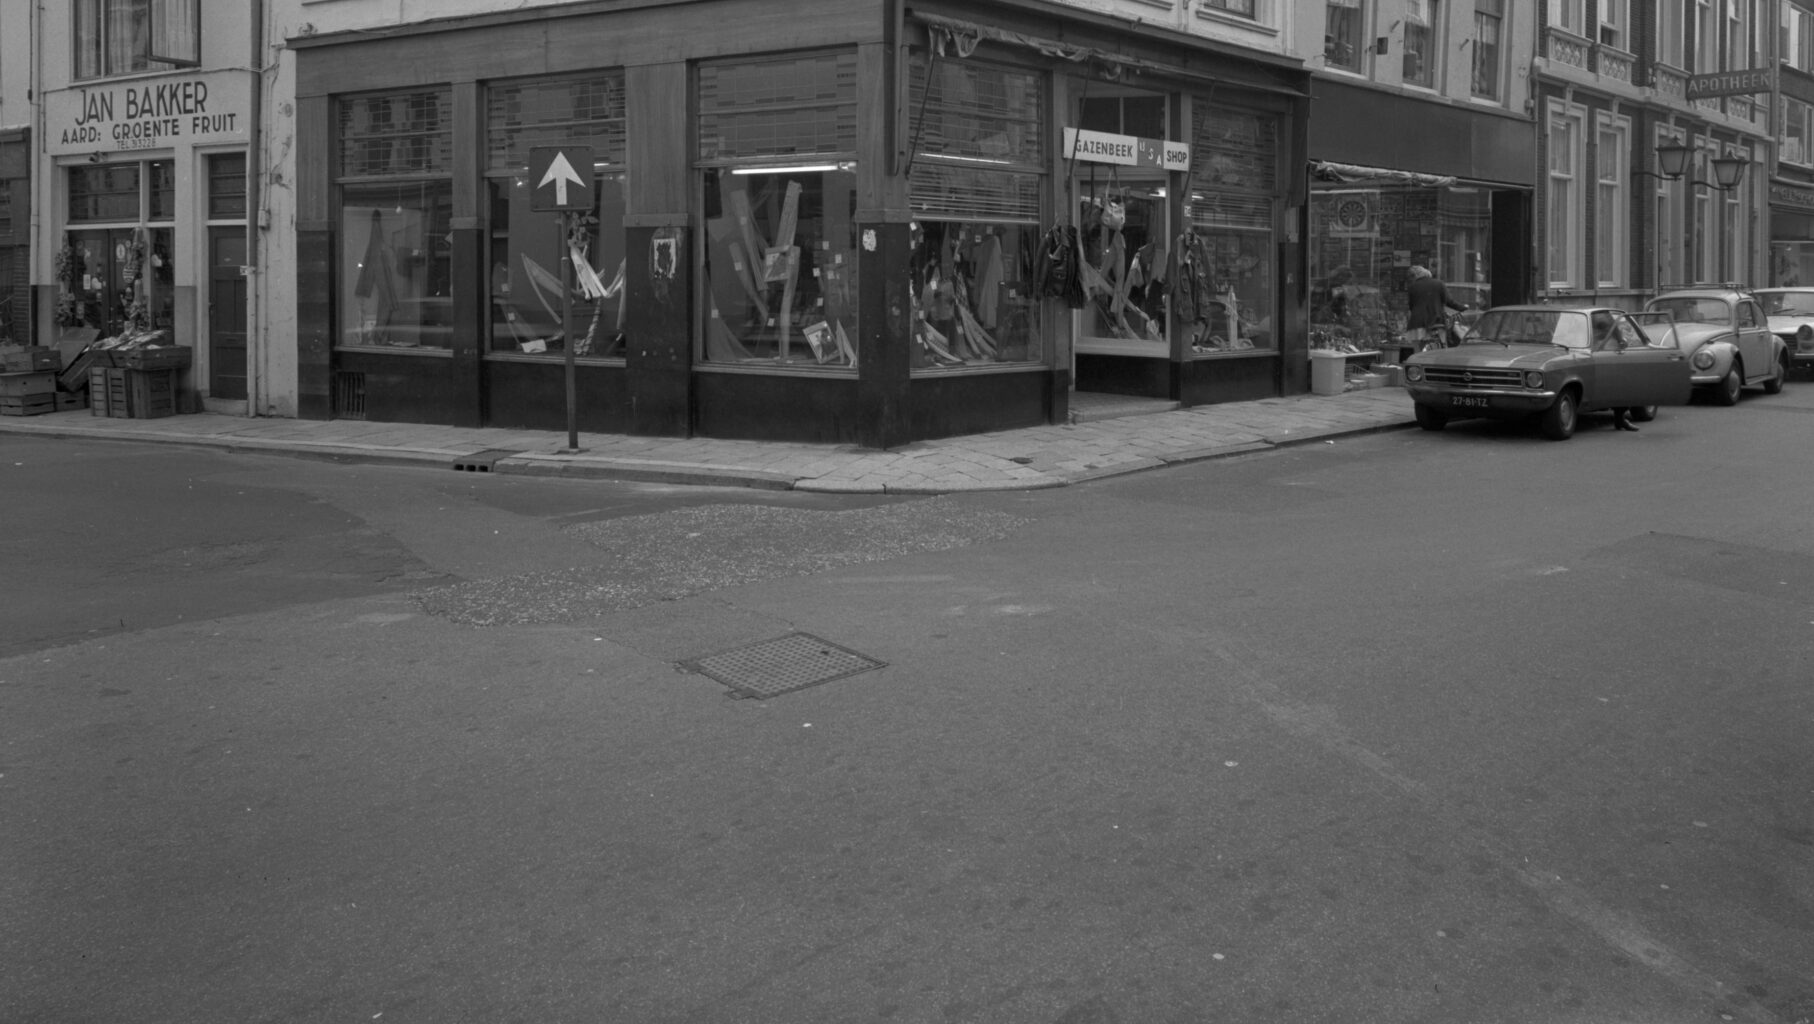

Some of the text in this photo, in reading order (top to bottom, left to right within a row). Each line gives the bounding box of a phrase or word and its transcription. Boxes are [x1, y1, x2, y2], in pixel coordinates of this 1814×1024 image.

[1687, 72, 1770, 94] APOTHEEK
[75, 81, 208, 126] JAN BAKKER
[61, 113, 236, 145] AARD: GROENTE FRUIT
[1076, 139, 1133, 158] GAZENBEEK
[1166, 150, 1188, 164] SHOP
